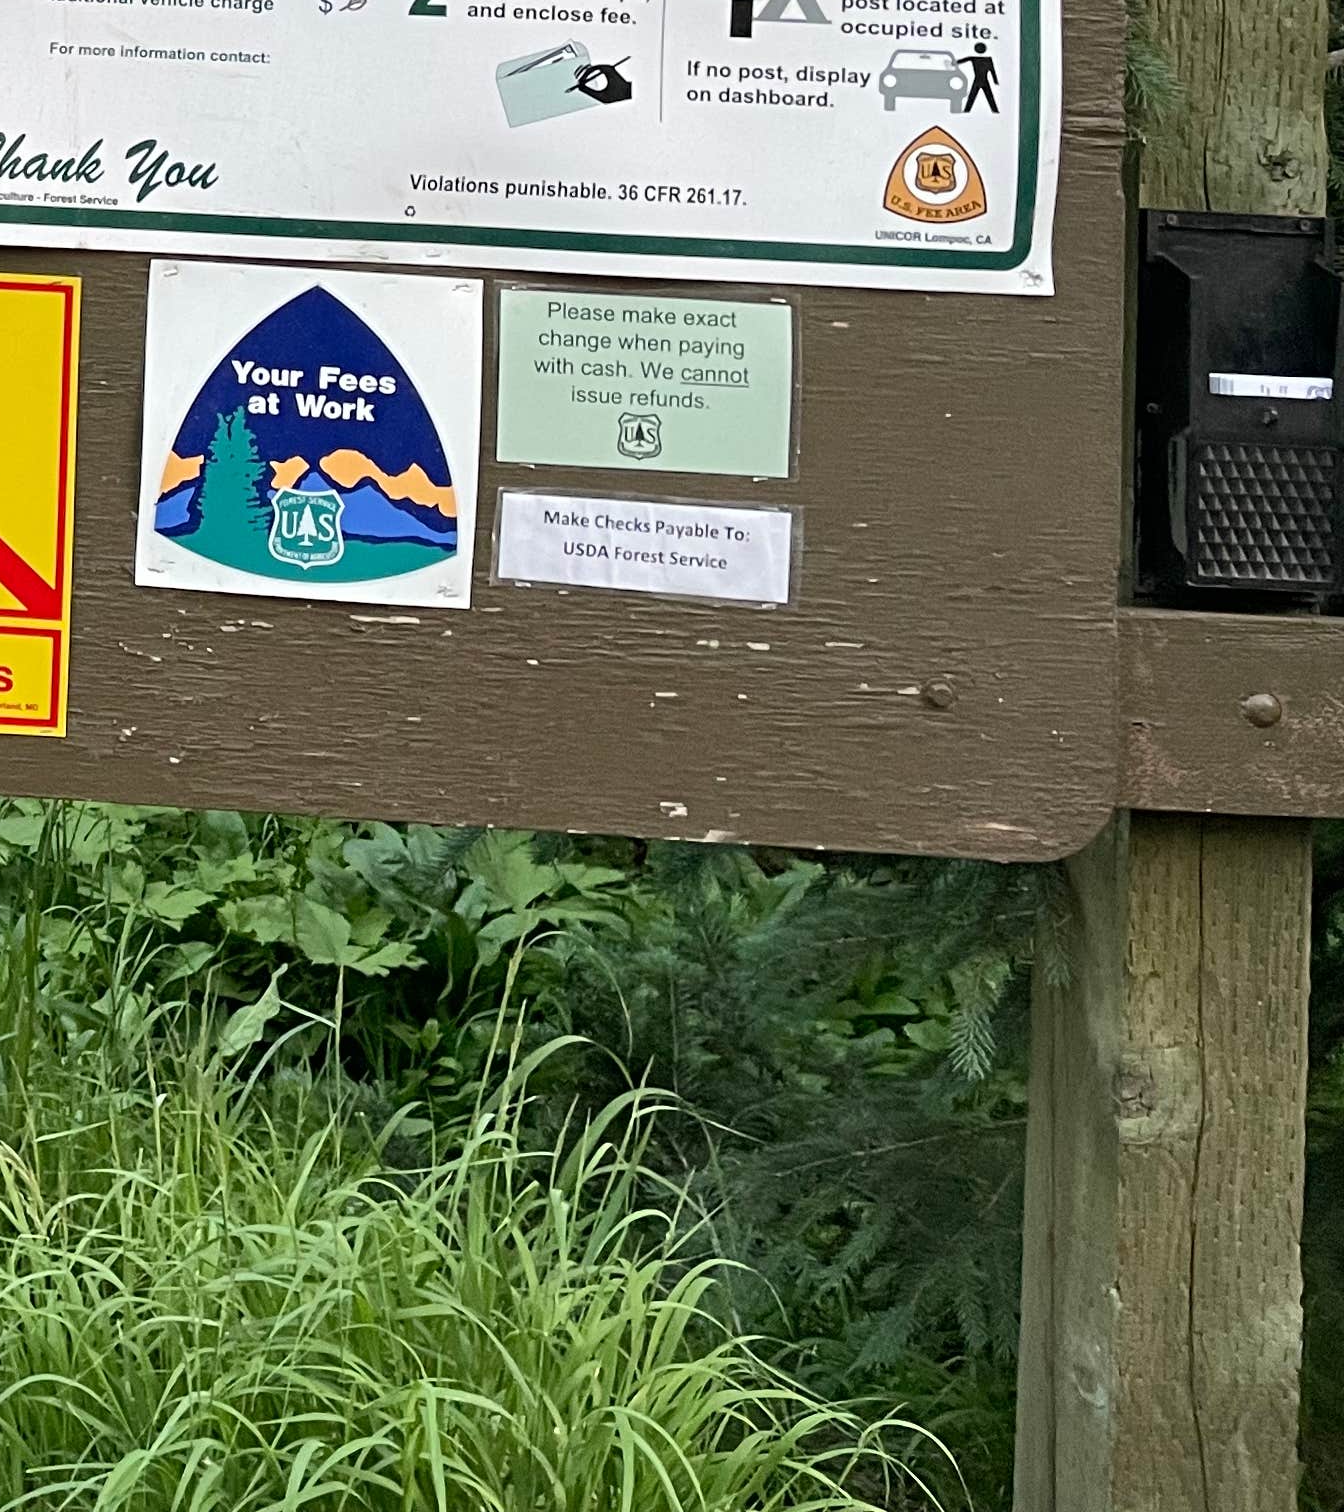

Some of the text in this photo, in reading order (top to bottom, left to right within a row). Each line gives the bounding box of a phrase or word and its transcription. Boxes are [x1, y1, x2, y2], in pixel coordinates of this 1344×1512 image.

[125, 140, 218, 203] You
[411, 175, 746, 205] Violations punishable. 36 CFR 261.17.
[548, 302, 736, 328] Please make exact
[539, 330, 744, 360] change when paying
[232, 360, 396, 394] Your Fees
[534, 358, 749, 385] with cash. We cannot
[248, 393, 374, 421] at Work
[572, 386, 710, 408] issue refunds.
[544, 511, 751, 541] Make Checks Payable To:
[564, 542, 727, 569] USDA Forest Service
